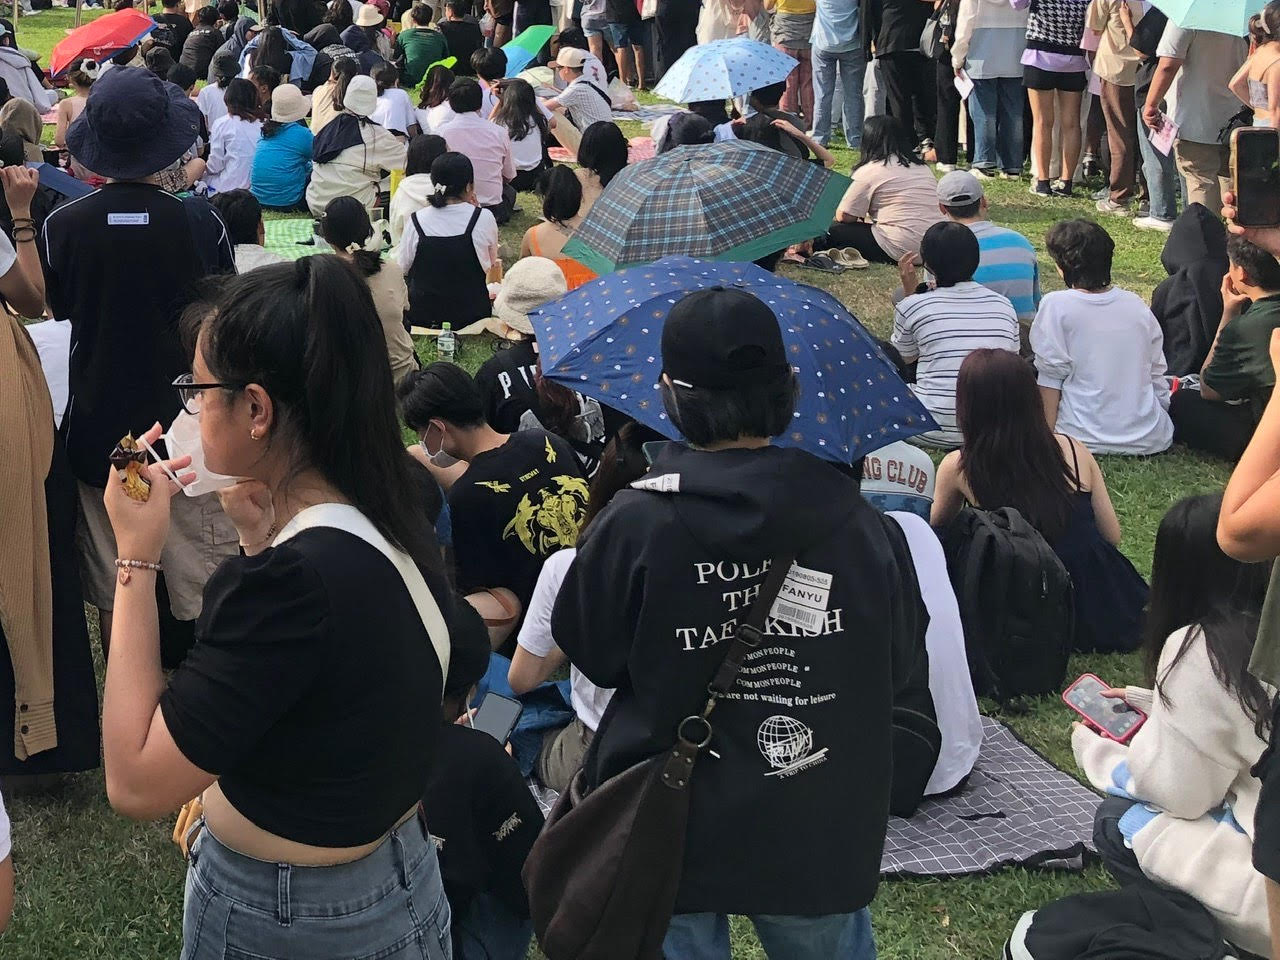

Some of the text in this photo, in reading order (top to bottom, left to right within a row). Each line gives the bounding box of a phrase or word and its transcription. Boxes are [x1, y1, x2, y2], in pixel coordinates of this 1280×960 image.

[887, 459, 928, 494] CLUB
[782, 584, 823, 603] FANYU
[743, 692, 759, 701] not
[761, 693, 793, 707] waiting
[794, 696, 809, 706] for
[810, 692, 837, 705] leisure
